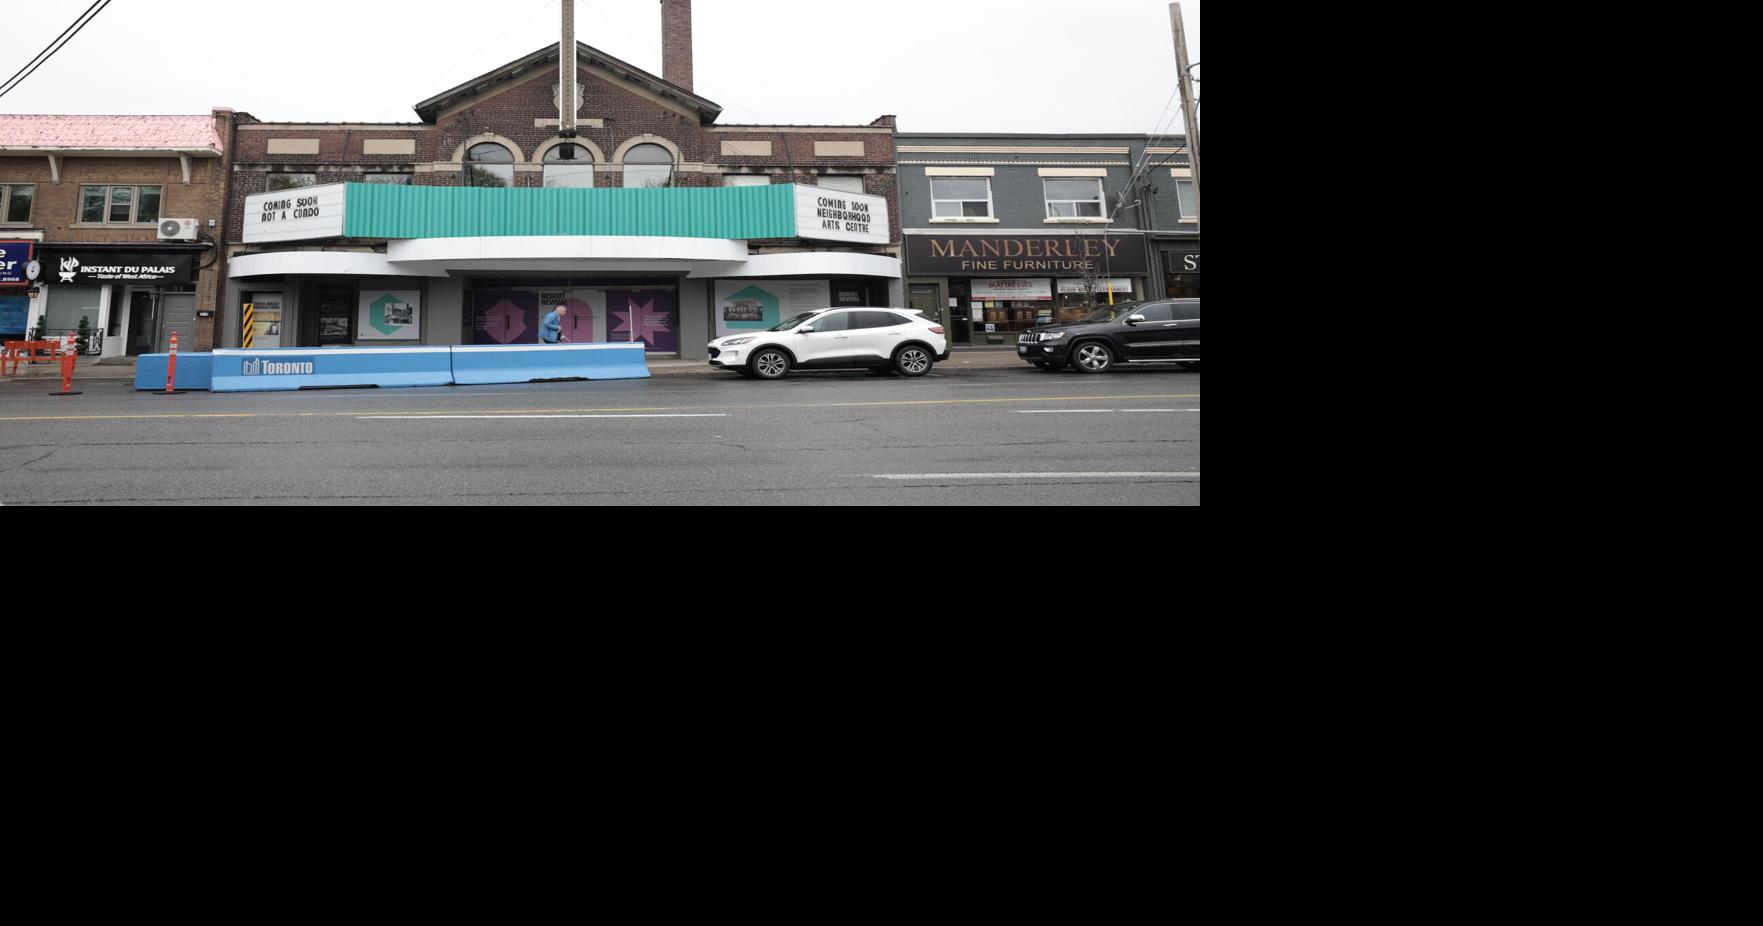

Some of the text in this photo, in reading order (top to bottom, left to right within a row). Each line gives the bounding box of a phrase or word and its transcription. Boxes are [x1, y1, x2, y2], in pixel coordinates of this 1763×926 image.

[264, 196, 318, 211] COMING SOON
[817, 197, 869, 212] COMING SOON
[262, 207, 319, 222] NOT A CONDO
[817, 208, 871, 223] NEIGHBORHOOD
[822, 220, 869, 233] ARTS CENTRE
[930, 239, 1121, 257] MANDERLEY
[141, 266, 176, 274] PALAIS
[962, 260, 1095, 270] FINE FURNITURE
[261, 360, 313, 375] TORONTO
